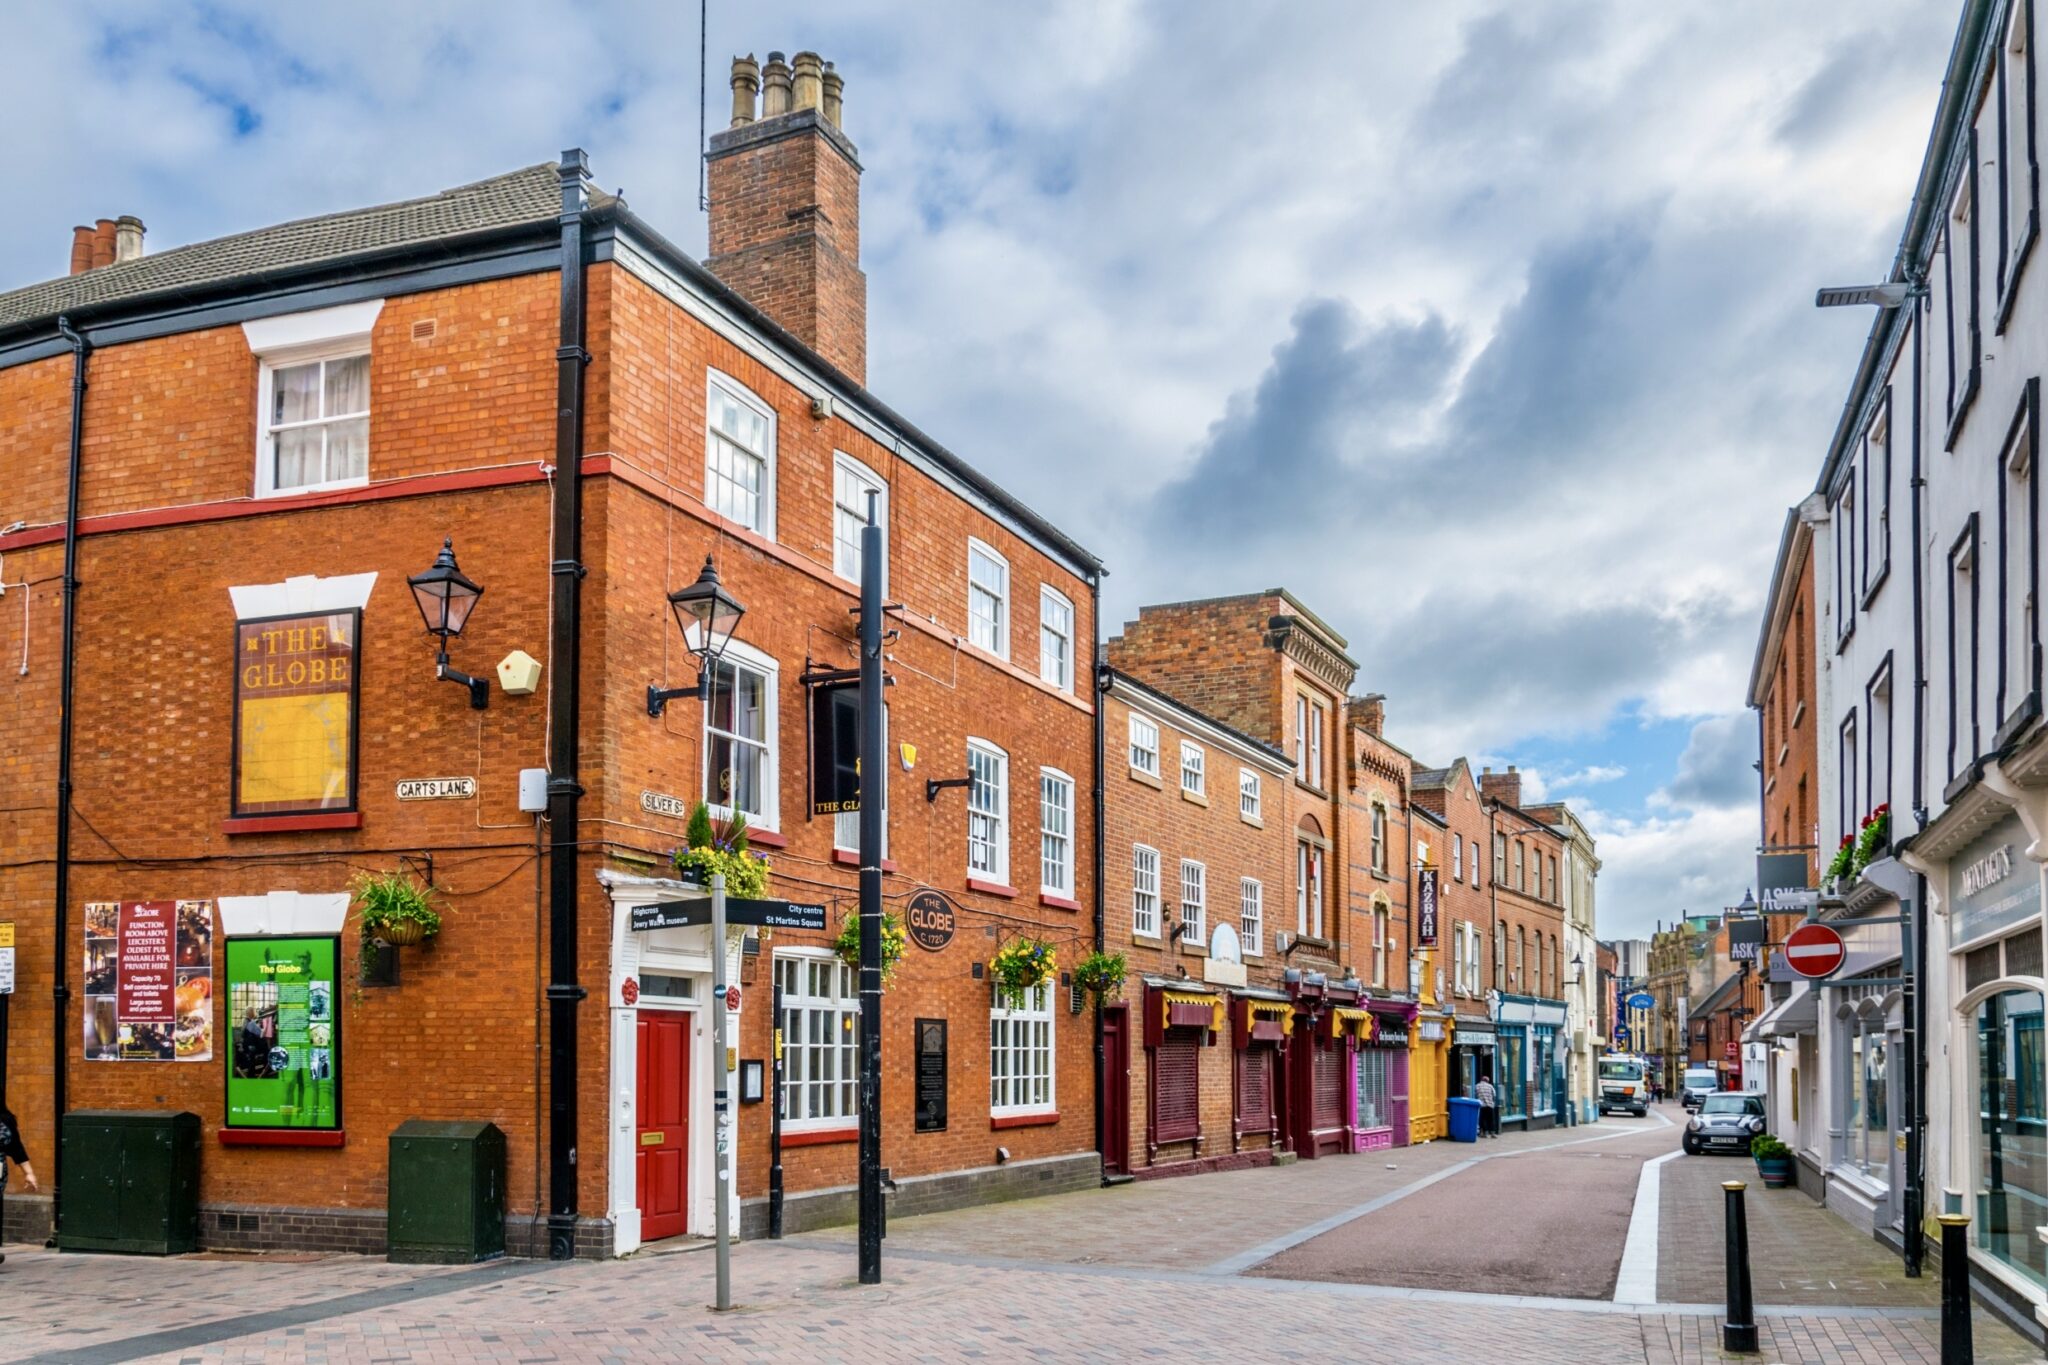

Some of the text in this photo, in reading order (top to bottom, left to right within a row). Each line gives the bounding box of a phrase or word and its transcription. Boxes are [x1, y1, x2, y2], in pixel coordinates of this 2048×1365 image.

[261, 626, 327, 655] THE
[242, 656, 348, 689] GLOBE
[400, 781, 469, 797] CARTS LANE
[645, 794, 673, 812] SILVER
[816, 800, 861, 813] THE GL
[788, 904, 824, 915] City centre
[924, 898, 941, 910] THE
[1422, 871, 1434, 937] KAZBAH
[633, 907, 659, 917] Highcross
[129, 921, 165, 929] FUNCTION
[633, 920, 648, 929] Jewry
[666, 917, 688, 925] museum
[766, 915, 824, 928] St Martins Square
[910, 908, 954, 932] GLOBE
[125, 929, 169, 938] ROOM ABOVE
[928, 934, 944, 945] 1720
[126, 946, 152, 954] OLDEST
[1731, 942, 1754, 959] ASK
[123, 954, 171, 962] AVAILABLE FOR
[124, 962, 168, 970] PRIVATE HIRE
[259, 964, 302, 974] The Globe
[153, 974, 162, 982] 70
[129, 999, 144, 1007] Large
